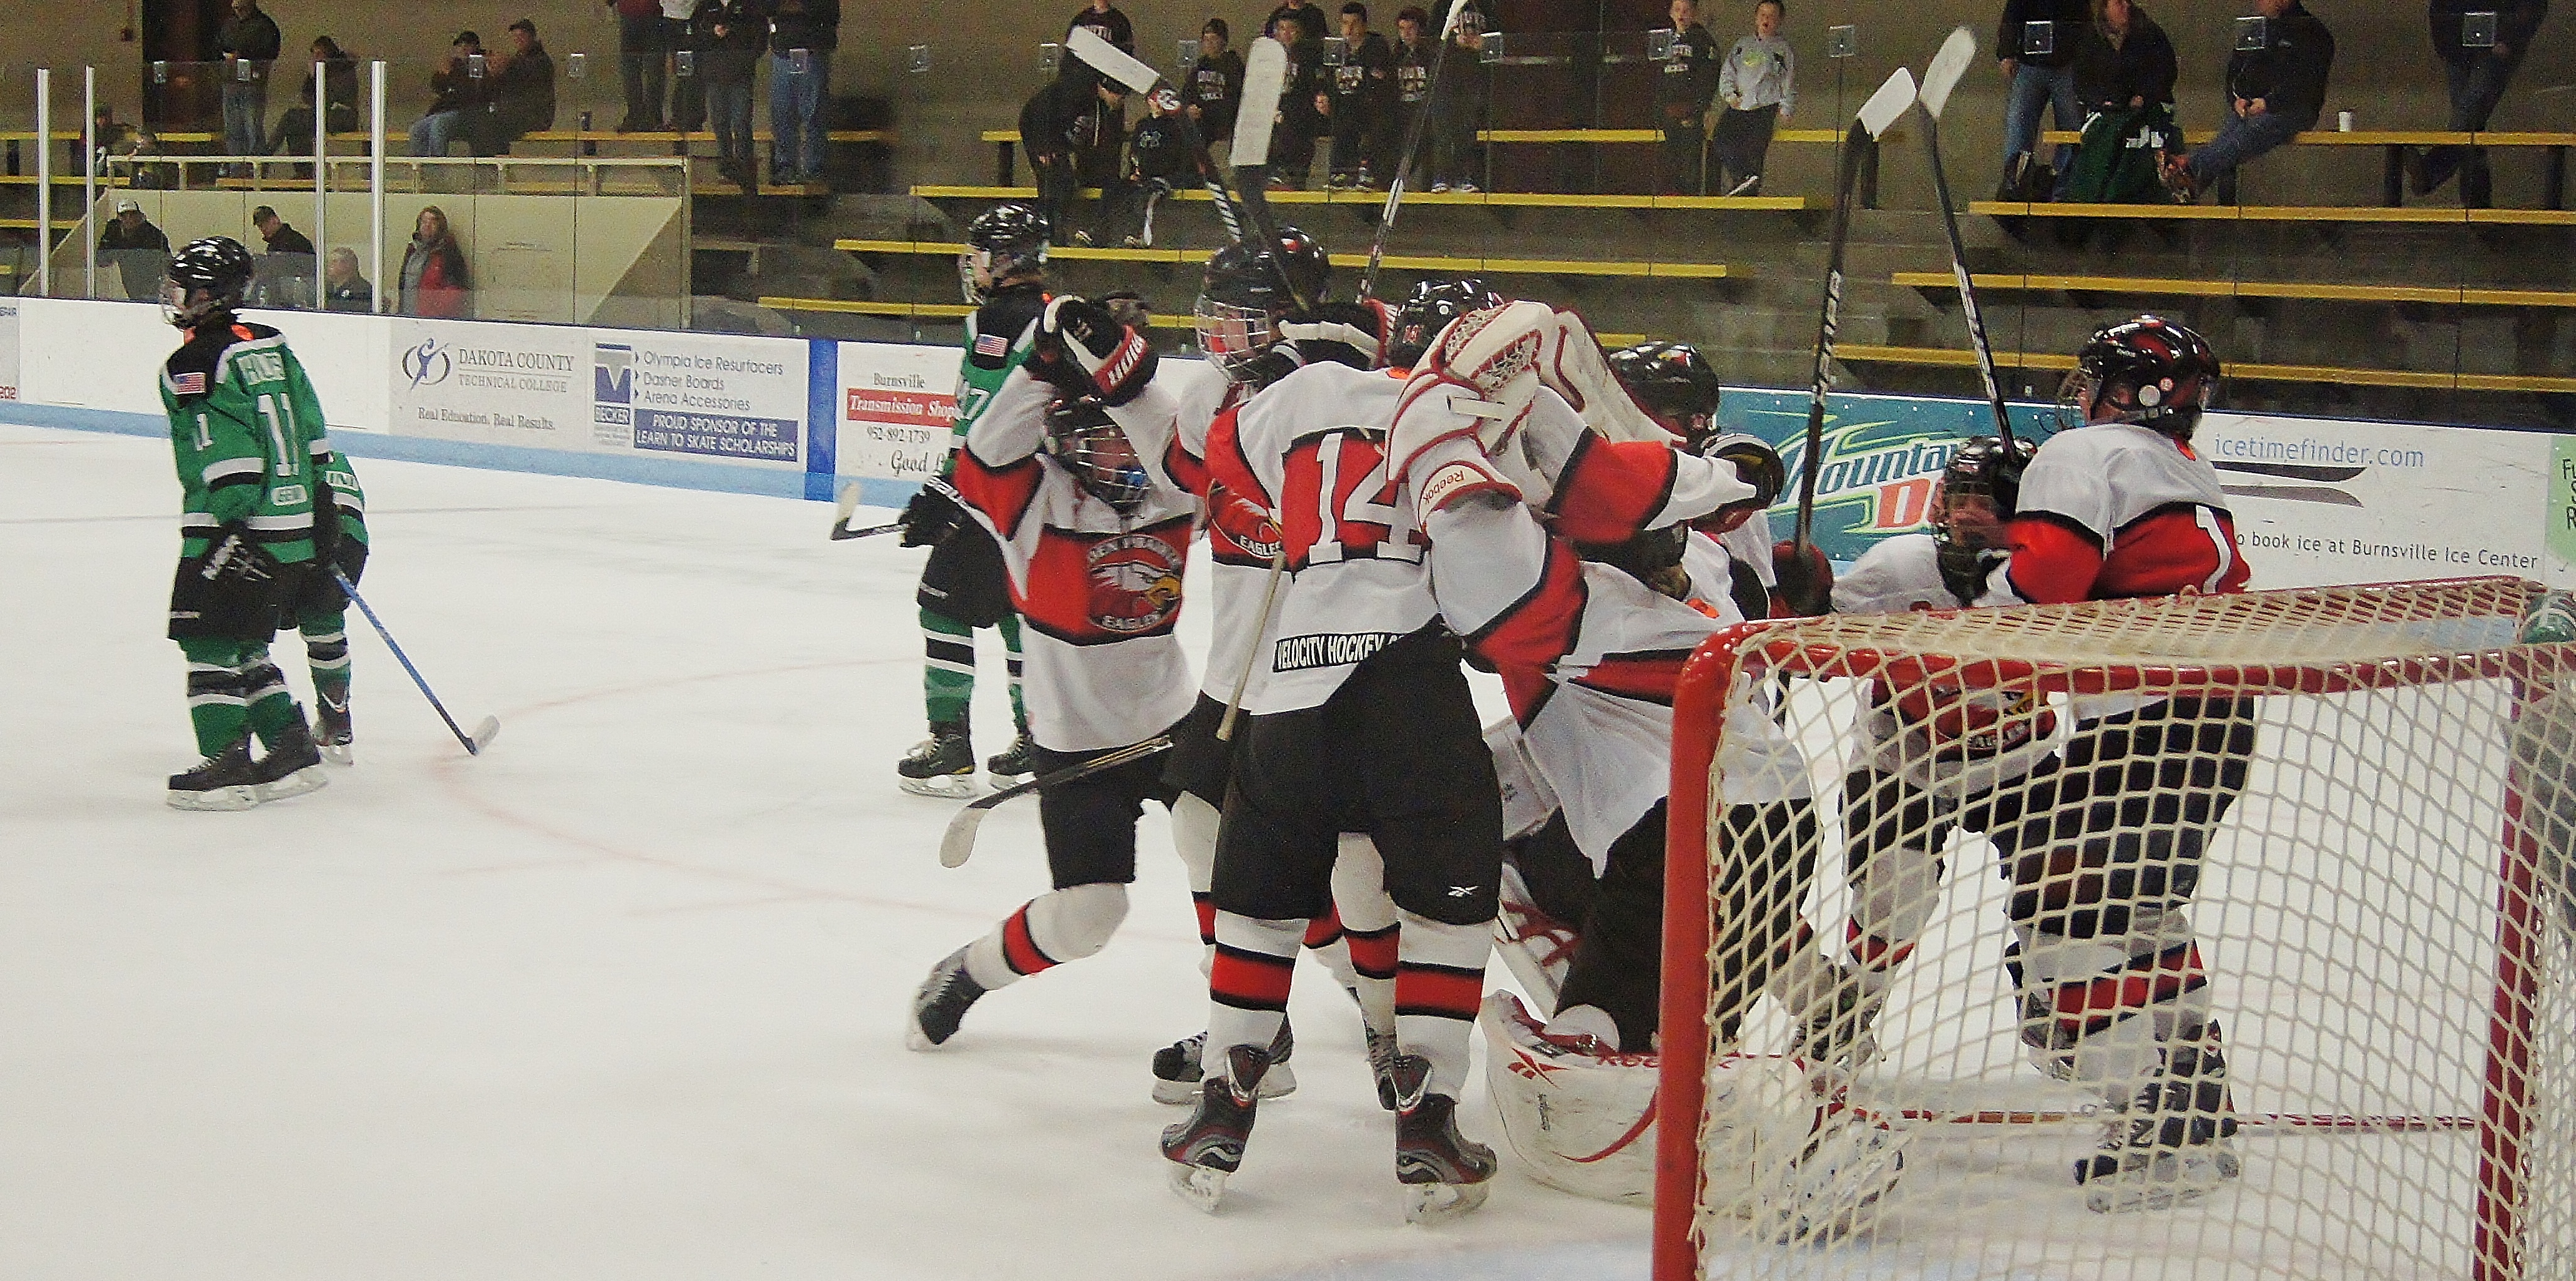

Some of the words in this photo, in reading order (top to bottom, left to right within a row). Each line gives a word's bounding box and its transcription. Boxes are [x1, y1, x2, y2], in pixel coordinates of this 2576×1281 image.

[459, 348, 513, 367] DAKOTA
[516, 352, 574, 371] COUNTY
[644, 351, 691, 369] Olympia
[694, 355, 712, 369] Ice
[716, 356, 783, 375] Resurfacers
[459, 374, 516, 389] TECHNICAL
[519, 378, 567, 393] COLLEGE
[644, 371, 682, 387] Dasher
[686, 374, 724, 390] Boards
[874, 373, 925, 388] Burnsville
[645, 390, 677, 405] Arena
[682, 392, 751, 410] Accessories
[849, 395, 924, 416] Transmission
[928, 400, 956, 423] Shop
[418, 407, 438, 420] Real
[441, 408, 490, 425] Education.
[493, 413, 514, 427] Real
[518, 414, 555, 430] Results.
[653, 414, 687, 430] PROUD
[691, 417, 739, 435] SPONSOR
[741, 420, 756, 436] OF
[760, 422, 778, 438] THE
[636, 430, 667, 445] LEARN
[670, 432, 685, 447] TO
[687, 433, 717, 450] SKATE
[719, 437, 796, 457] SCHOLARSHIPS
[2215, 433, 2425, 468] icetimefinder.com
[891, 449, 929, 477] Good
[1309, 432, 1422, 564] 14
[1422, 470, 1465, 504] Reebok
[1240, 535, 1282, 556] EAGLES
[2252, 531, 2289, 549] book
[2297, 535, 2321, 552] ice
[2328, 538, 2344, 554] at
[2352, 539, 2437, 561] Burnsville
[2445, 546, 2470, 563] Ice
[2478, 548, 2538, 569] Center
[1277, 636, 1324, 670] VELOCITY
[1327, 634, 1385, 663] HOCKEY
